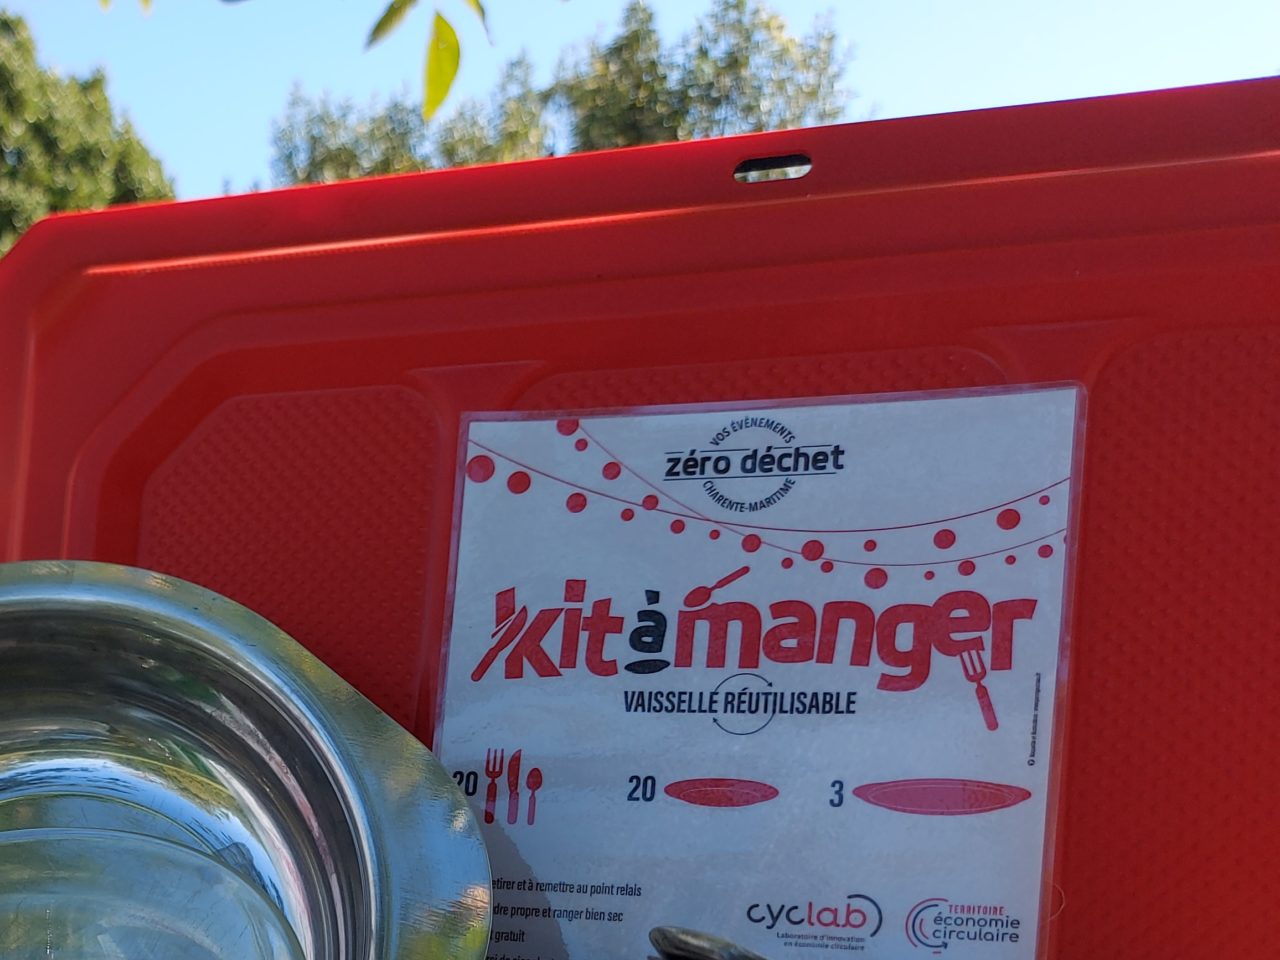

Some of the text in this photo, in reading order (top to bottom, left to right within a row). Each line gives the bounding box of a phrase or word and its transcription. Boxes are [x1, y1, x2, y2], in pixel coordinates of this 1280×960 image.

[709, 427, 731, 446] VOS
[665, 445, 845, 477] zéro déchet
[703, 476, 796, 513] CHARENTE-MARITIME
[624, 687, 857, 715] VAISSELLE RÉUTILISABLE
[628, 775, 656, 802] 20
[829, 780, 844, 807] 3
[492, 877, 642, 897] etirer et à remettre au point relais
[511, 906, 540, 919] propre
[542, 906, 551, 918] et
[553, 909, 583, 922] ranger
[585, 907, 605, 921] bien
[608, 910, 623, 922] sec
[746, 901, 867, 929] cyclab
[933, 911, 1020, 929] économie
[949, 904, 1004, 916] TERRITOIRE
[494, 929, 525, 943] gratuit
[932, 926, 1020, 943] circulaire
